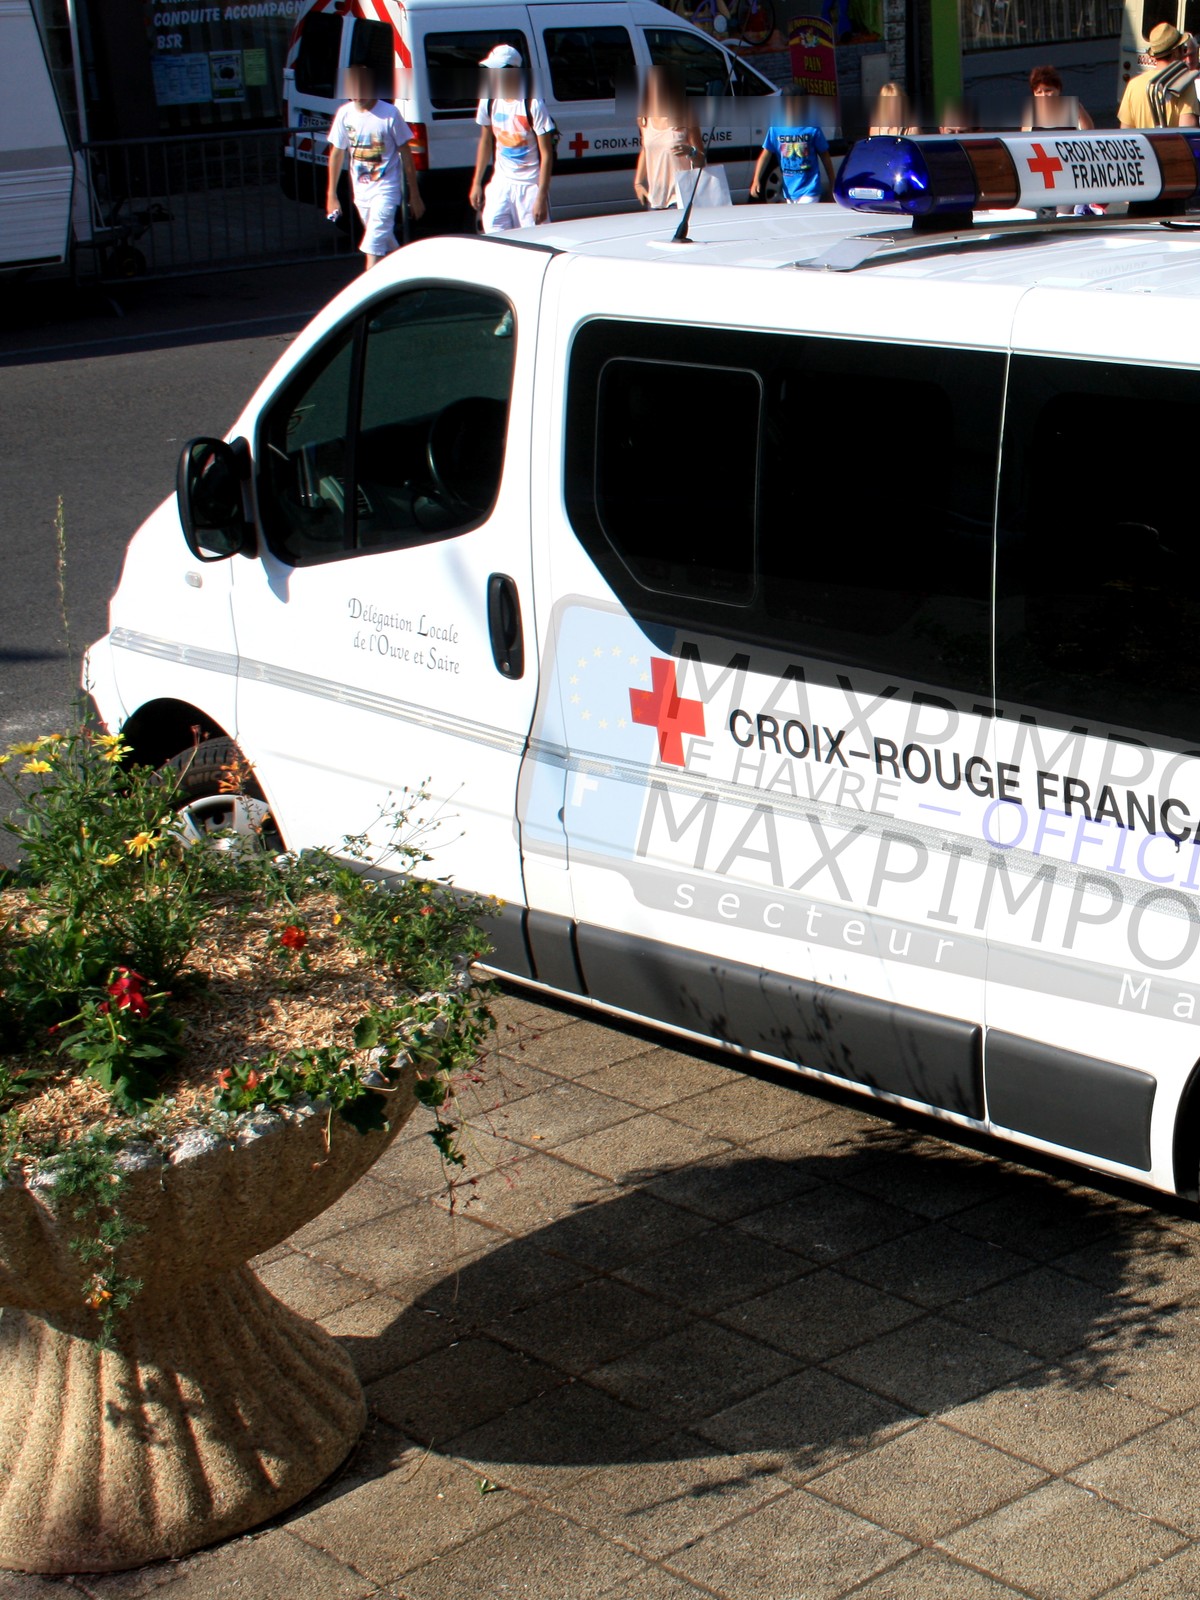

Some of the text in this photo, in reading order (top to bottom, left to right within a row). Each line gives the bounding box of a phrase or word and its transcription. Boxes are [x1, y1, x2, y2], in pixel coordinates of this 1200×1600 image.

[153, 7, 221, 27] CONDUITE
[156, 34, 183, 49] BSR
[804, 55, 822, 72] PAIN
[1055, 139, 1145, 163] CROIX-ROUGE
[1071, 162, 1145, 189] FRANCAISE
[348, 597, 459, 643] Délégation Locale
[353, 630, 366, 650] de
[413, 650, 424, 665] et
[426, 646, 460, 674] Saire
